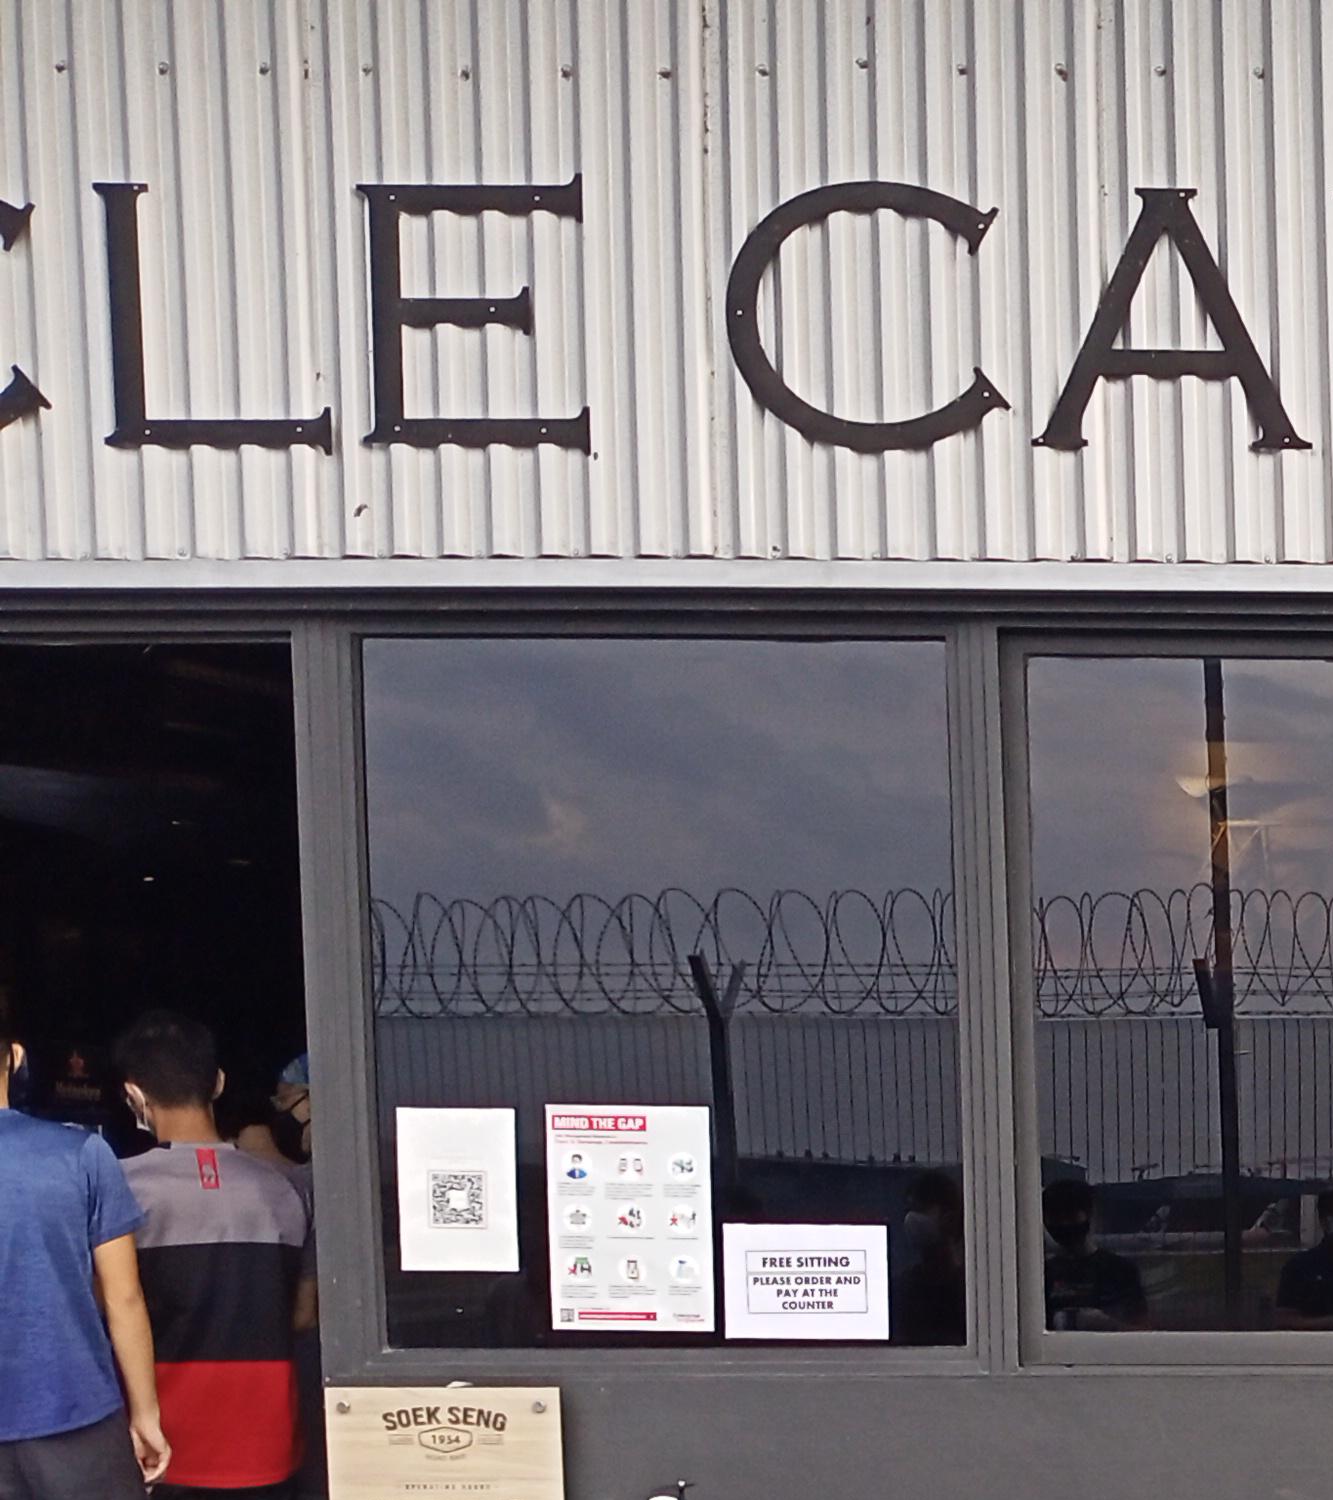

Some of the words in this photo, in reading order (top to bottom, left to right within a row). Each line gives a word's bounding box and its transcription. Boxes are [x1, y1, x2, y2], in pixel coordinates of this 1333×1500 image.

[554, 1116, 590, 1130] MIND
[591, 1117, 616, 1130] THE
[617, 1117, 645, 1131] GAP
[762, 1257, 793, 1268] FREE
[796, 1256, 851, 1268] SITTING
[752, 1276, 792, 1286] PLEASE
[794, 1276, 832, 1285] ORDER
[835, 1275, 862, 1285] AND
[776, 1288, 799, 1298] PAY
[801, 1288, 816, 1298] AT
[818, 1288, 839, 1298] THE
[781, 1300, 834, 1310] COUNTER
[382, 1405, 442, 1432] SOEK
[447, 1405, 508, 1432] SENG
[431, 1434, 462, 1445] 1954
